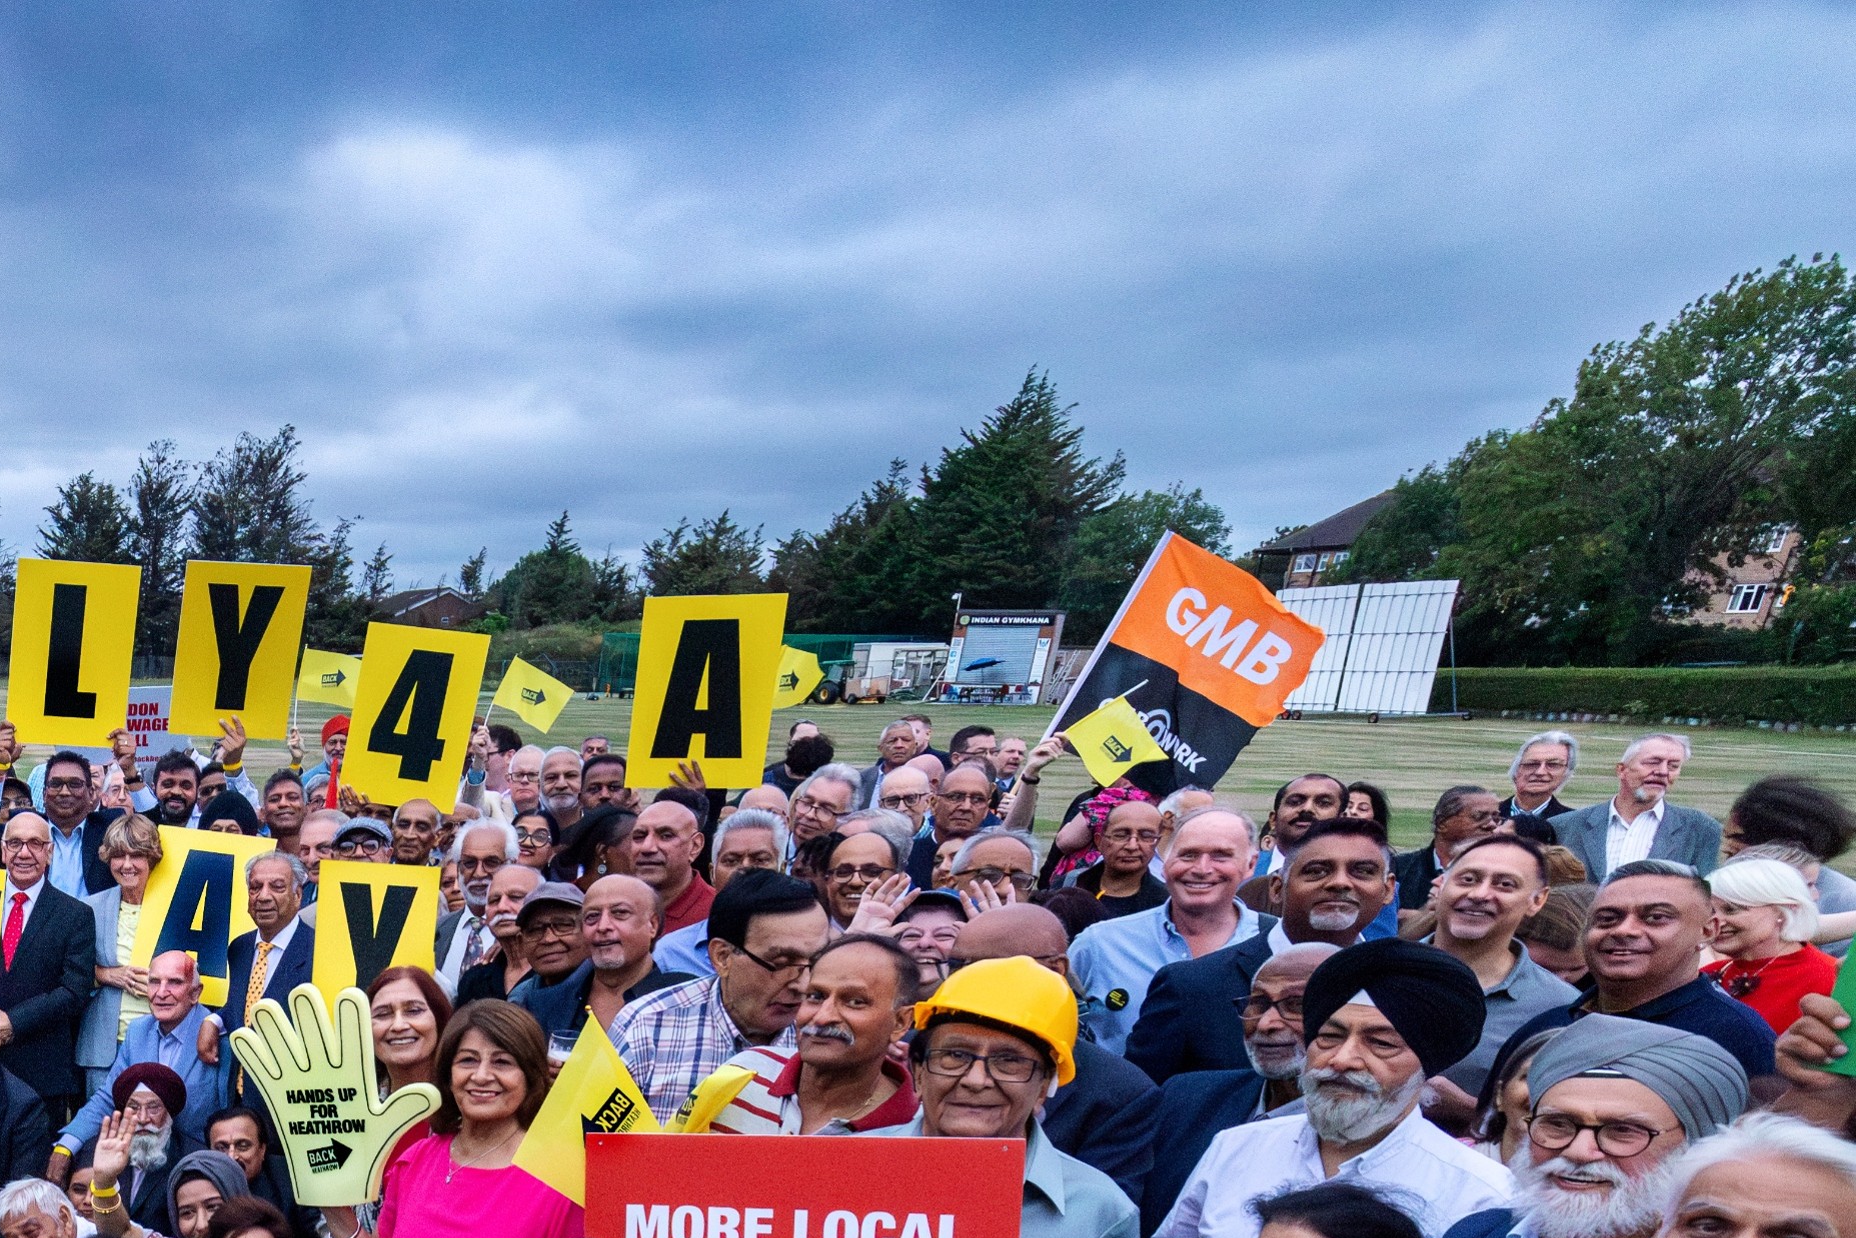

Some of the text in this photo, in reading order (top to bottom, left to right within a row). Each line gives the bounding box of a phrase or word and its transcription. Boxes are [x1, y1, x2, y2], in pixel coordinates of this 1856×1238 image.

[1001, 616, 1050, 624] GYMKHANA
[1165, 587, 1292, 685] GMB
[650, 619, 743, 759] A
[127, 702, 159, 716] DON
[126, 717, 169, 732] WAGE
[286, 1087, 357, 1104] HANDS UP
[310, 1104, 339, 1118] FOR
[288, 1119, 365, 1135] HEATHROW
[308, 1148, 337, 1165] BACK
